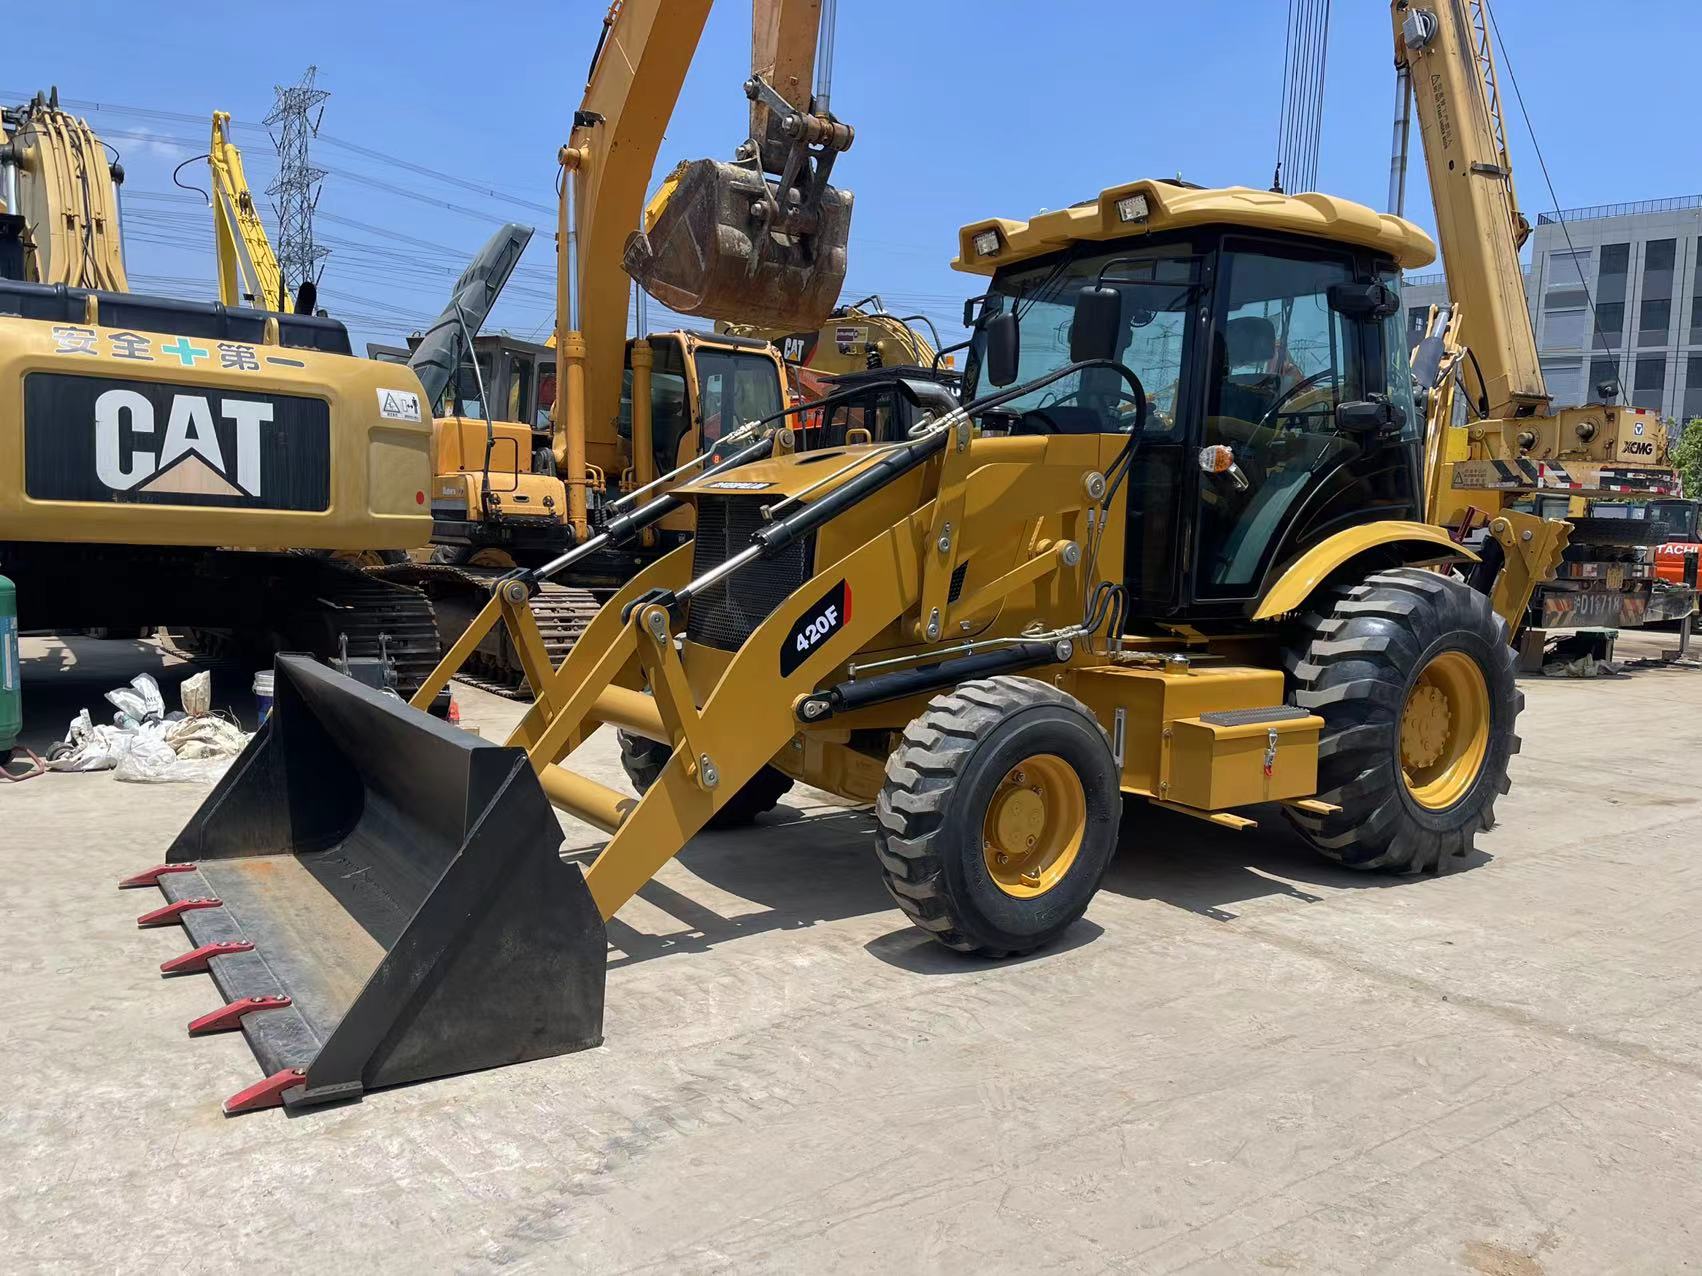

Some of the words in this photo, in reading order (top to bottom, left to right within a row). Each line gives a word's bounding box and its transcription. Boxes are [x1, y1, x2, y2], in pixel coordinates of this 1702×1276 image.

[52, 326, 154, 361] 安全
[217, 342, 305, 371] 第一
[784, 338, 805, 362] CAT
[95, 389, 274, 497] CAT
[1622, 441, 1653, 455] XCMG
[796, 604, 838, 652] 420F
